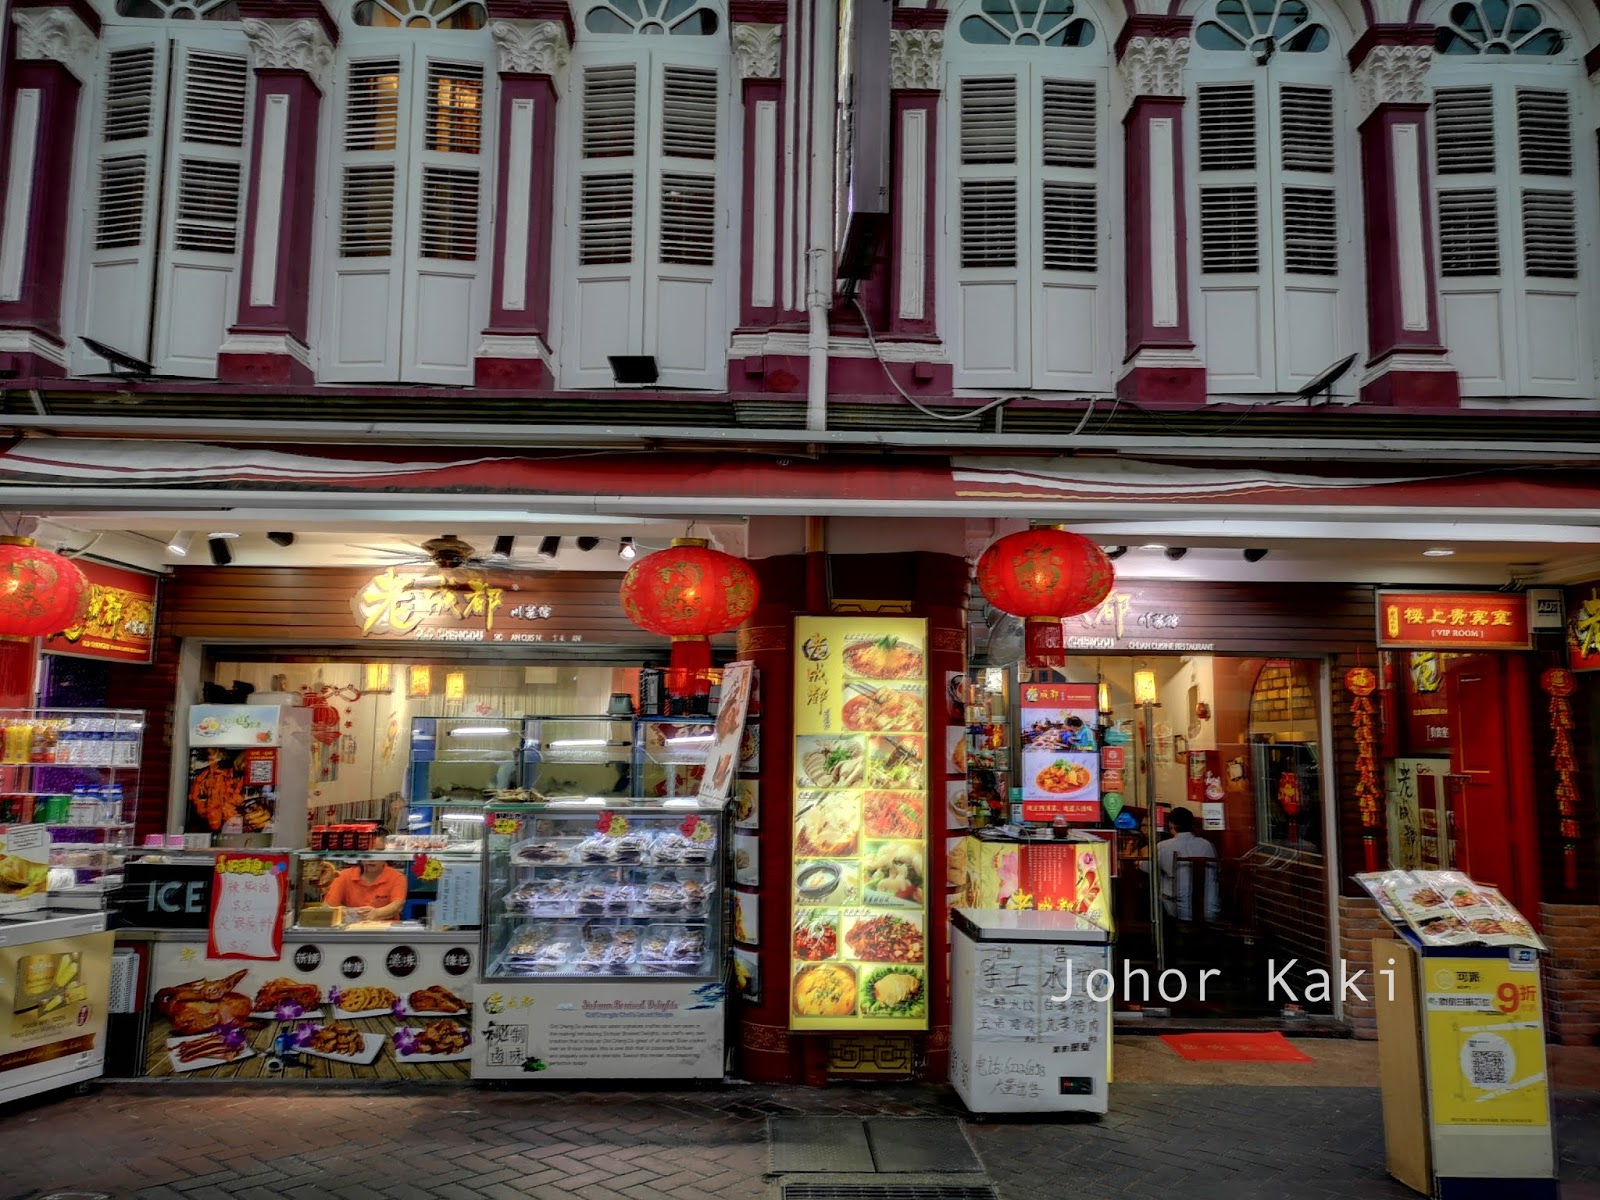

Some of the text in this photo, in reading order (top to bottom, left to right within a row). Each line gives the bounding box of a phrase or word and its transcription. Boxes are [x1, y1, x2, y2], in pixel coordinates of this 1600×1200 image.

[1404, 608, 1514, 627] 楼上贵宾室
[147, 880, 204, 913] ICE
